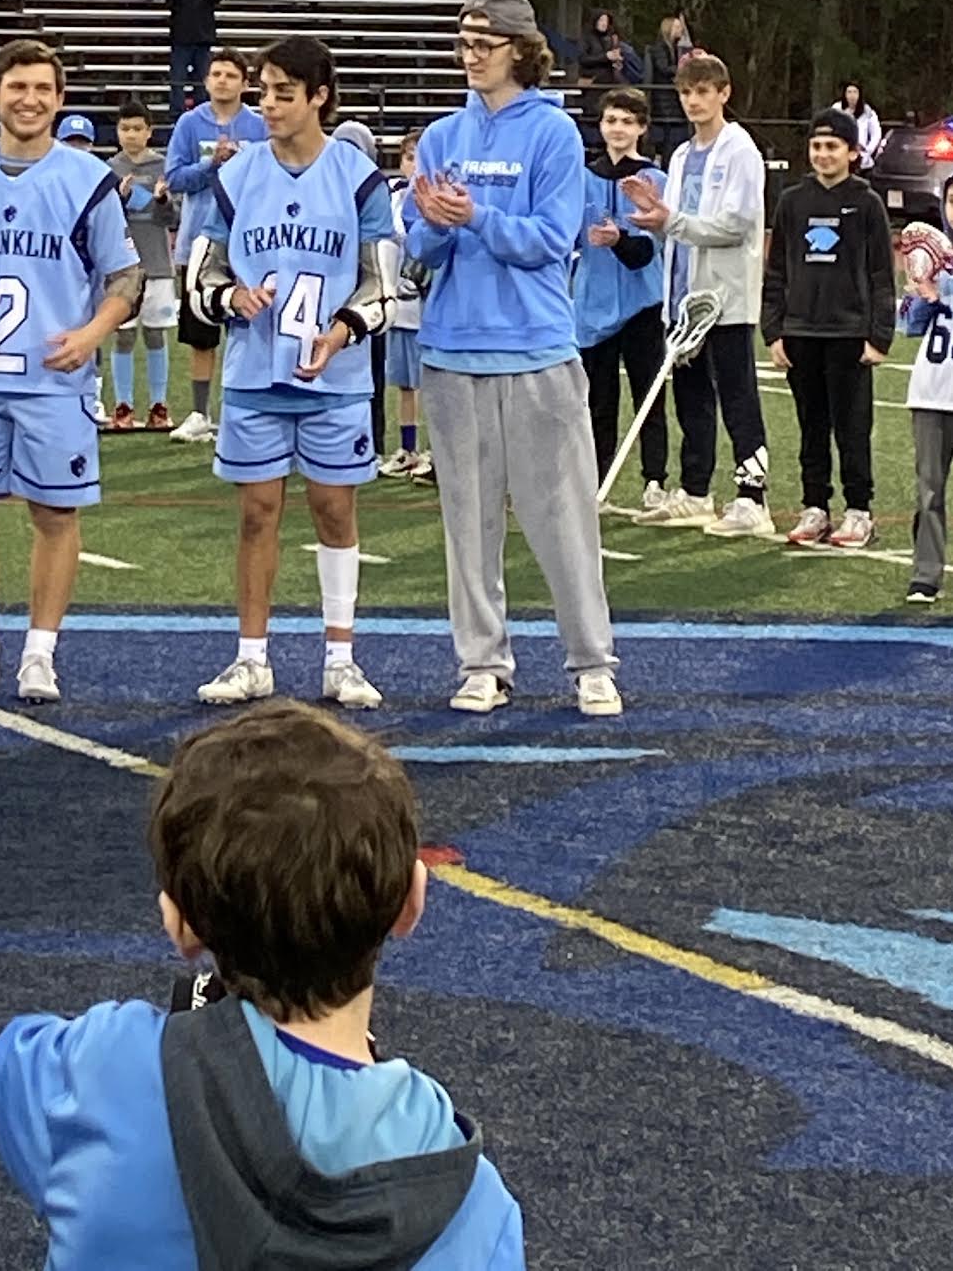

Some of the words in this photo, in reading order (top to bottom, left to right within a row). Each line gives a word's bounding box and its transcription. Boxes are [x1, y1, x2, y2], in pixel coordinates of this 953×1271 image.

[242, 223, 347, 258] FRANKLIN
[261, 270, 326, 371] 4
[926, 303, 953, 364] 6
